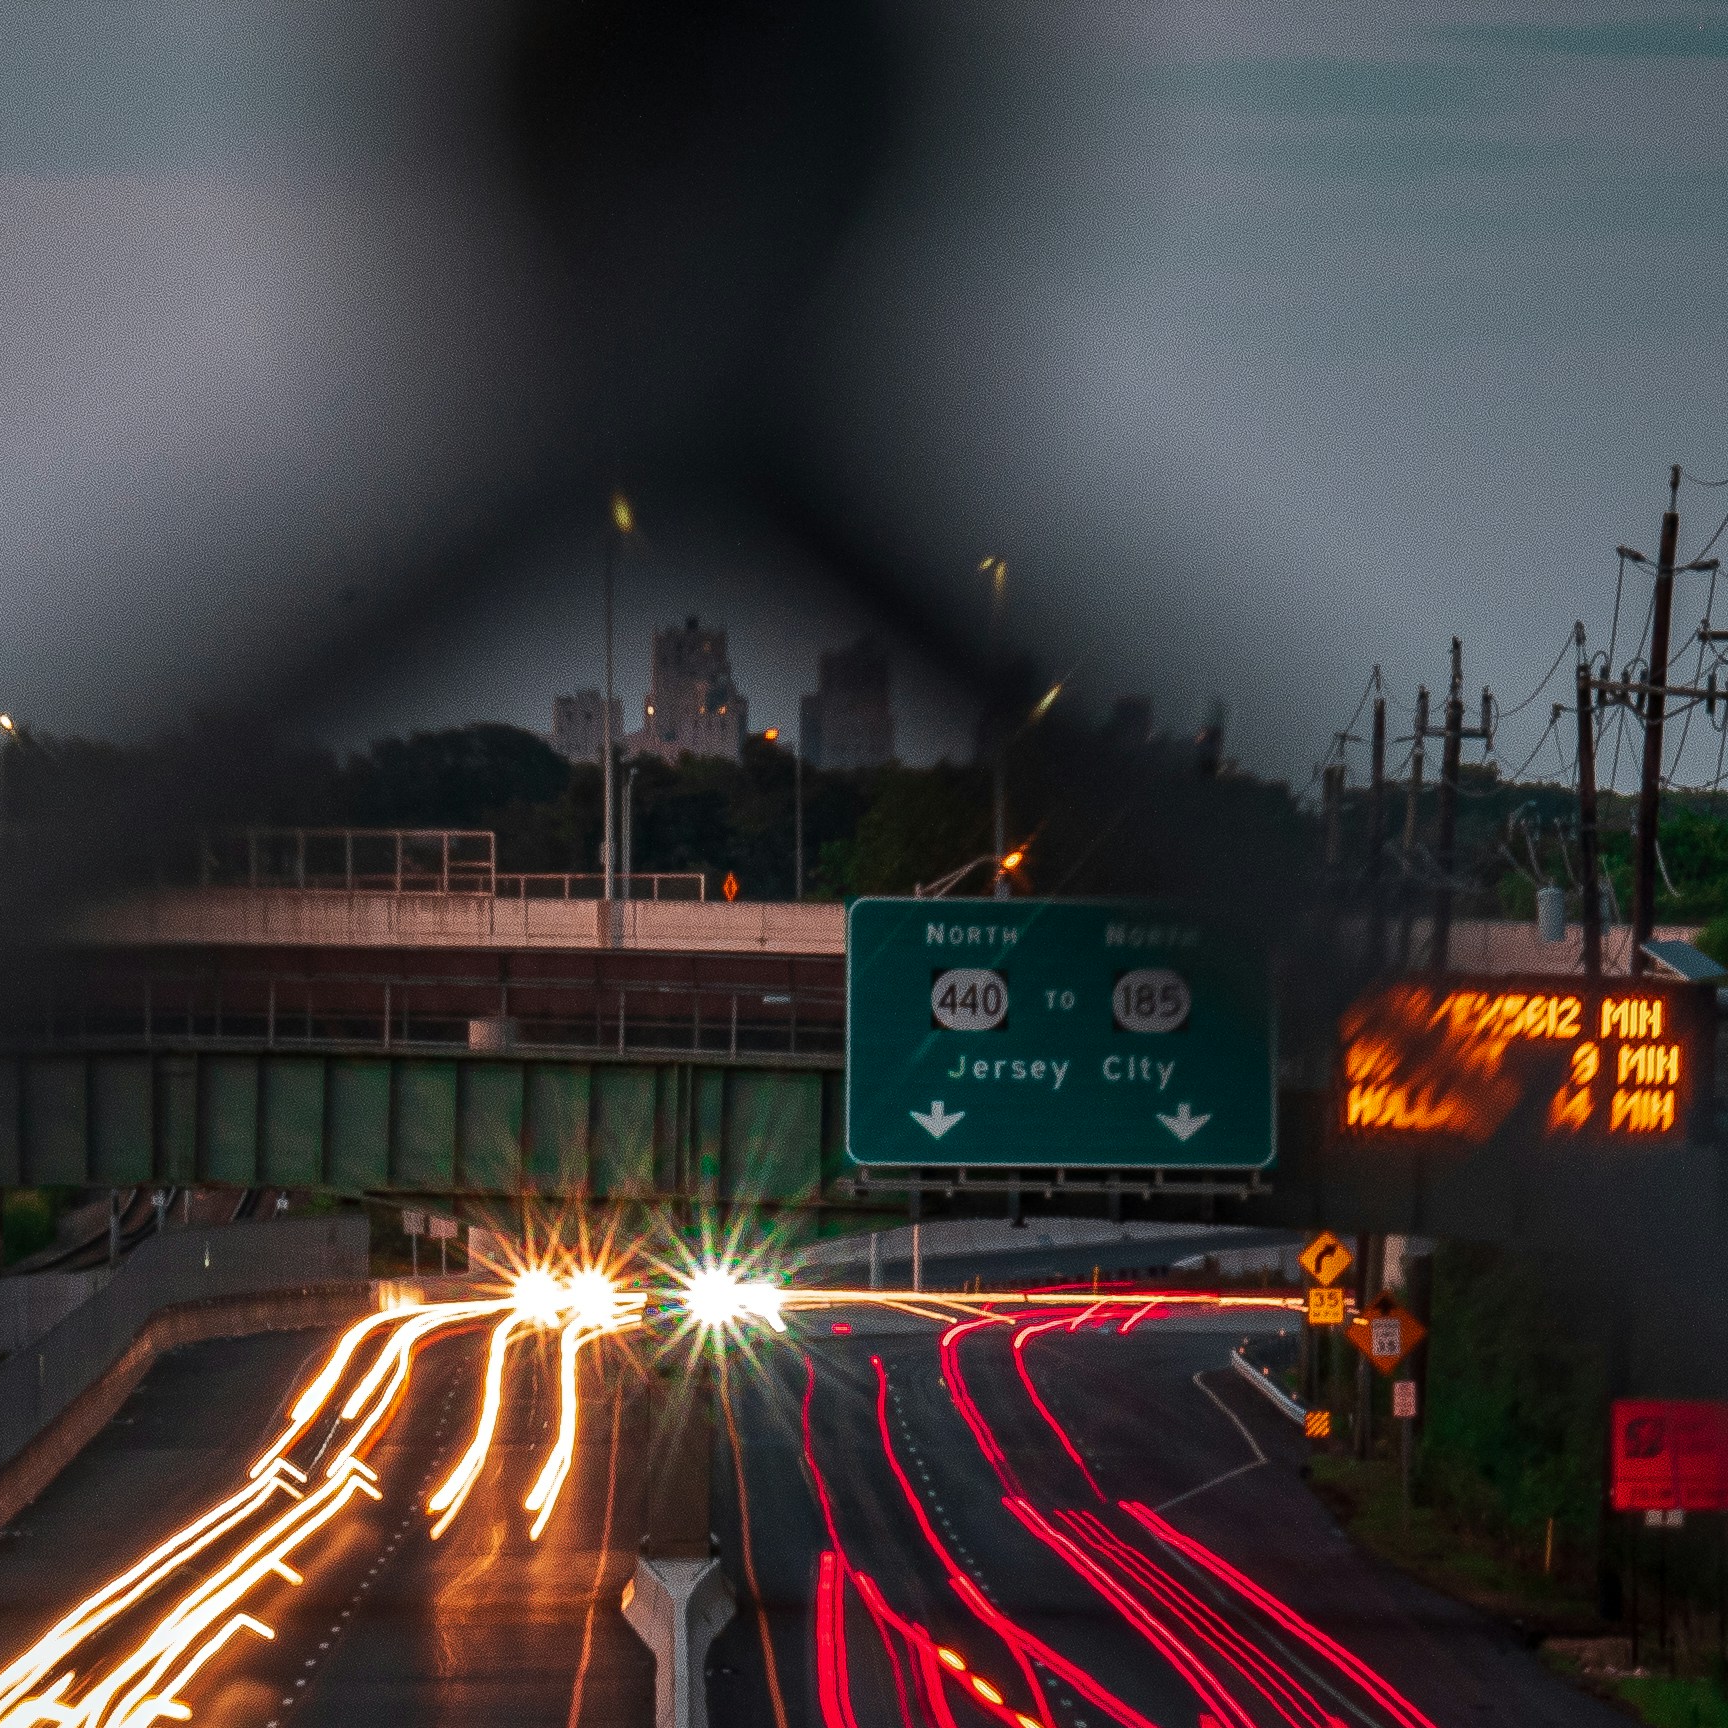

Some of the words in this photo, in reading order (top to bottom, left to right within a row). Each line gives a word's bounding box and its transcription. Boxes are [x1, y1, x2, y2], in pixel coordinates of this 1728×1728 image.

[925, 922, 1019, 945] NORTH
[938, 982, 1002, 1017] 440
[1044, 989, 1076, 1010] TO
[1122, 983, 1183, 1018] 185
[947, 1054, 1071, 1091] Jersey
[1101, 1055, 1176, 1092] City
